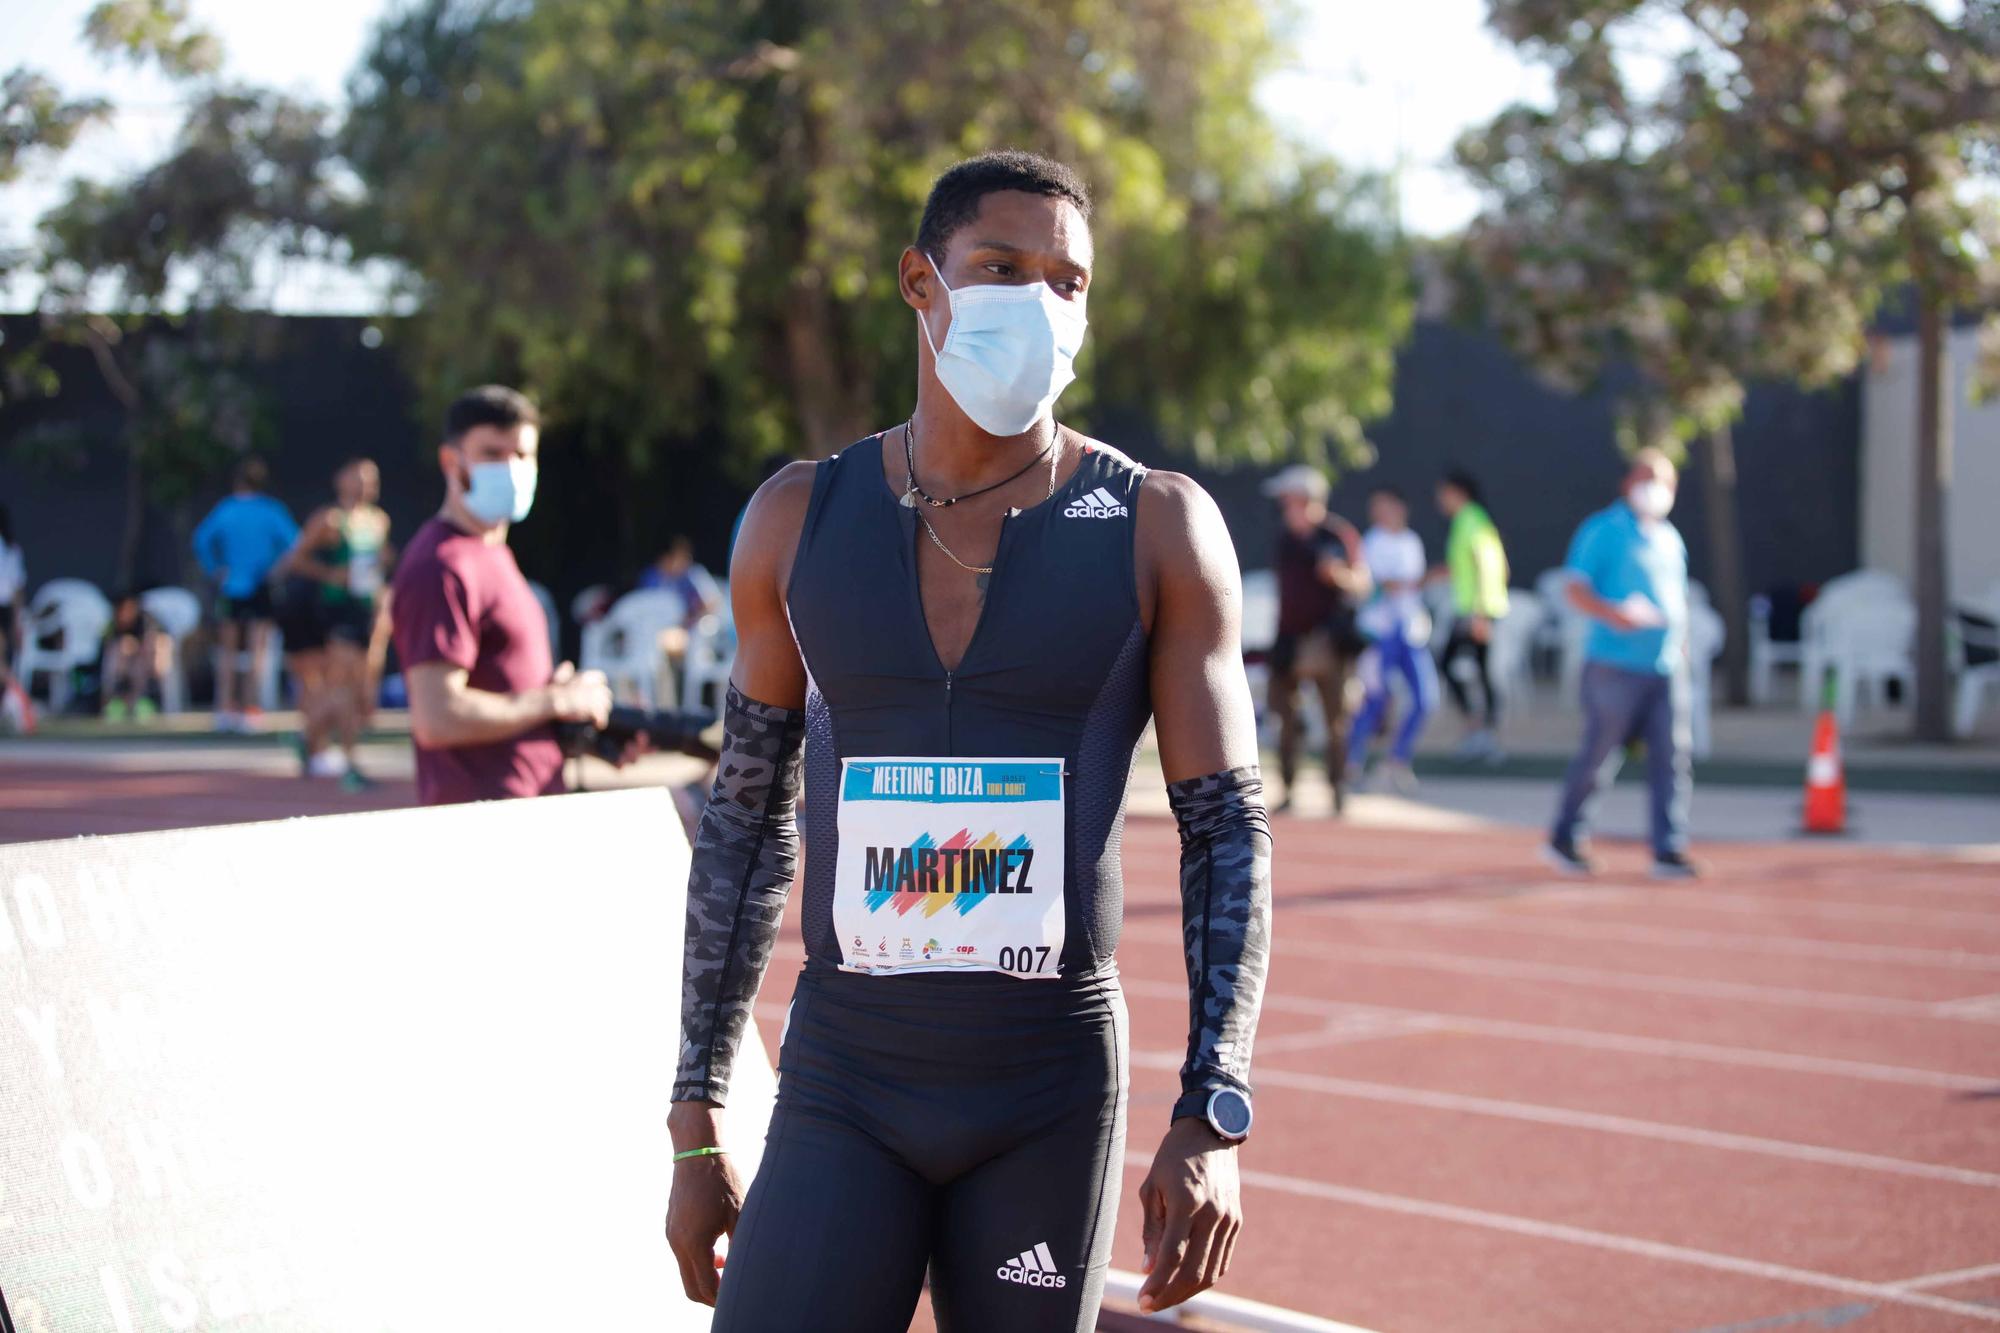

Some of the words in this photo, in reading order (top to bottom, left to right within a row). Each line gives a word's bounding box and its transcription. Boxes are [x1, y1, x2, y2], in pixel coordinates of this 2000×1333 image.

[1064, 505, 1128, 519] adidas
[872, 766, 934, 795] MEETING
[940, 767, 984, 796] IBIZA
[864, 846, 1034, 893] MARTINEZ
[999, 946, 1051, 973] 007
[996, 1266, 1066, 1288] adidas
